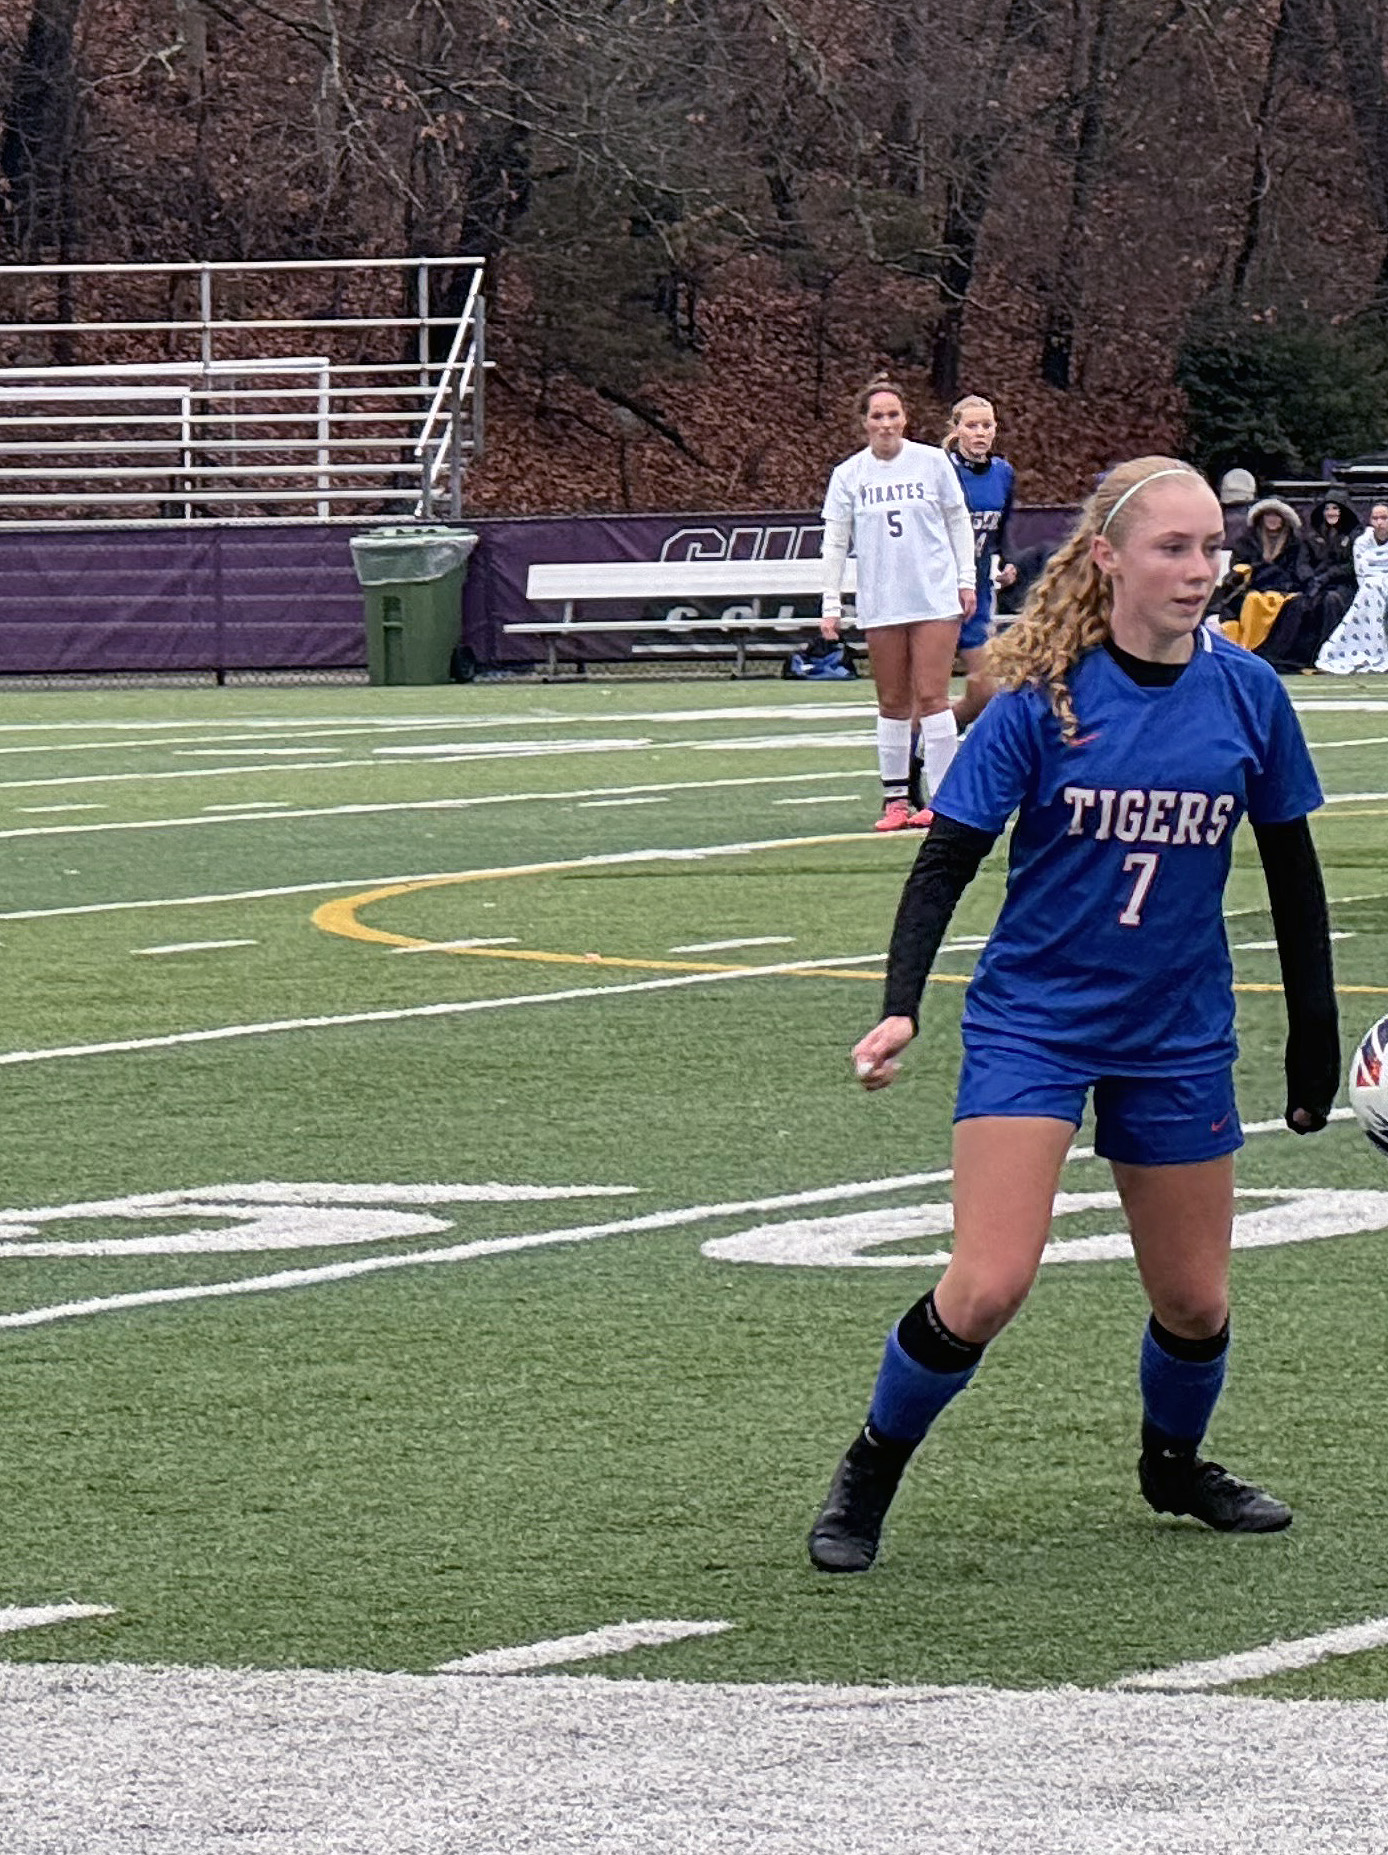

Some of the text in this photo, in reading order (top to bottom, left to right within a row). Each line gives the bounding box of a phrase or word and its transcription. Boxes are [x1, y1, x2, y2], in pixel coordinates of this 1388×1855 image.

[860, 482, 925, 507] PIRATES
[886, 510, 903, 538] 5
[1063, 786, 1235, 846] TIGERS
[1119, 852, 1161, 926] 7
